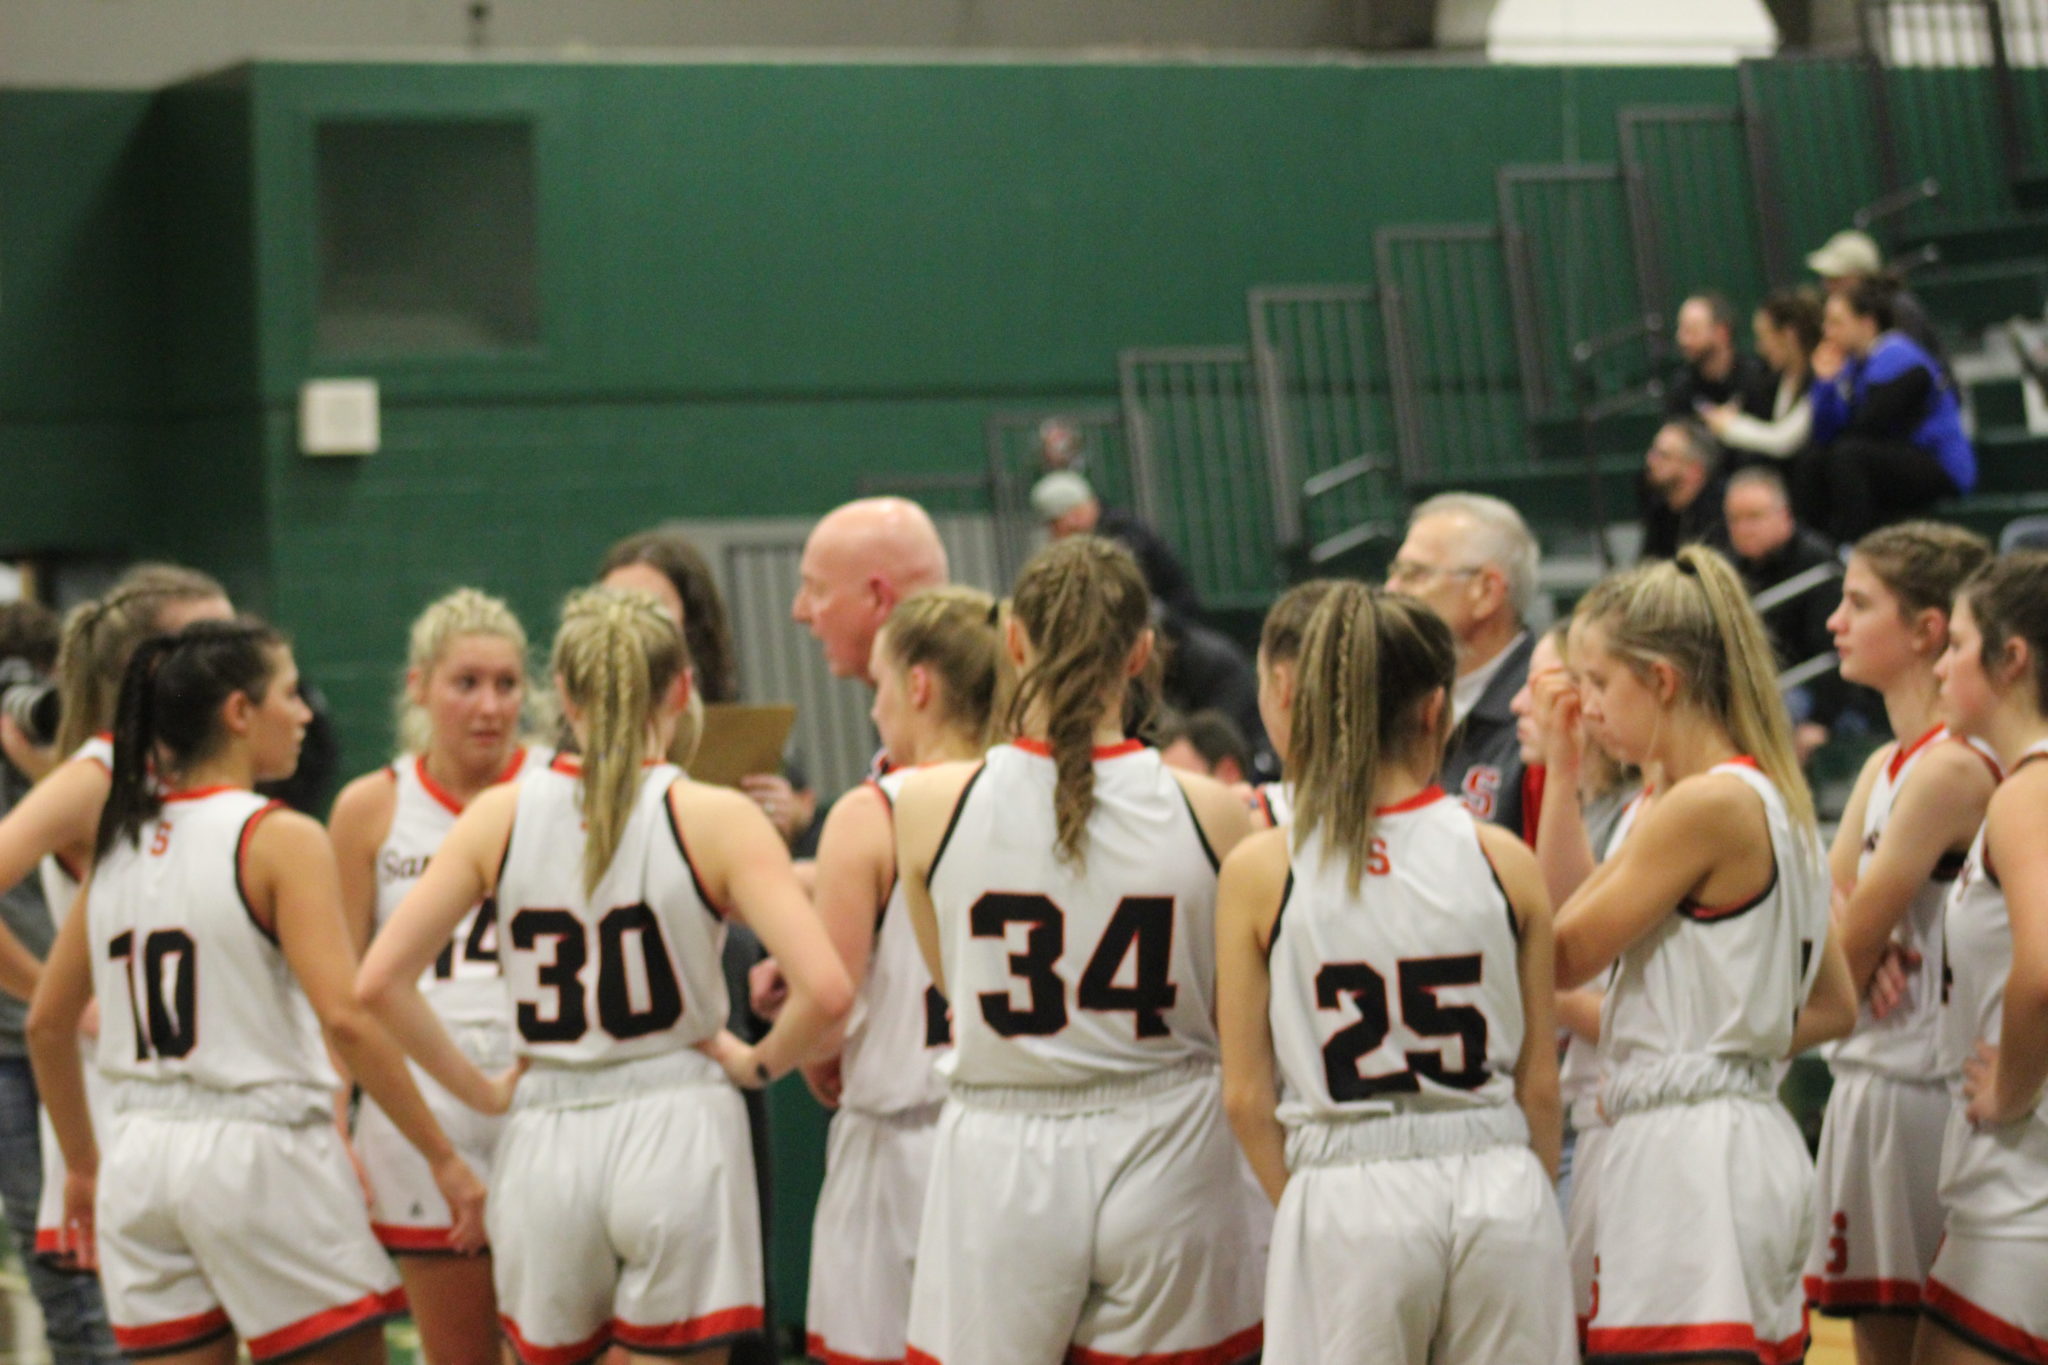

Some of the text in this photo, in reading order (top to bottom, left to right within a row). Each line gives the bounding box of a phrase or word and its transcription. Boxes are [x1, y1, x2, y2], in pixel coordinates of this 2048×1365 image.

[150, 821, 173, 857] S
[1366, 837, 1391, 876] S
[1461, 764, 1501, 820] S
[109, 928, 197, 1062] 10
[510, 901, 684, 1044] 30
[969, 890, 1177, 1041] 34
[1315, 953, 1492, 1104] 25
